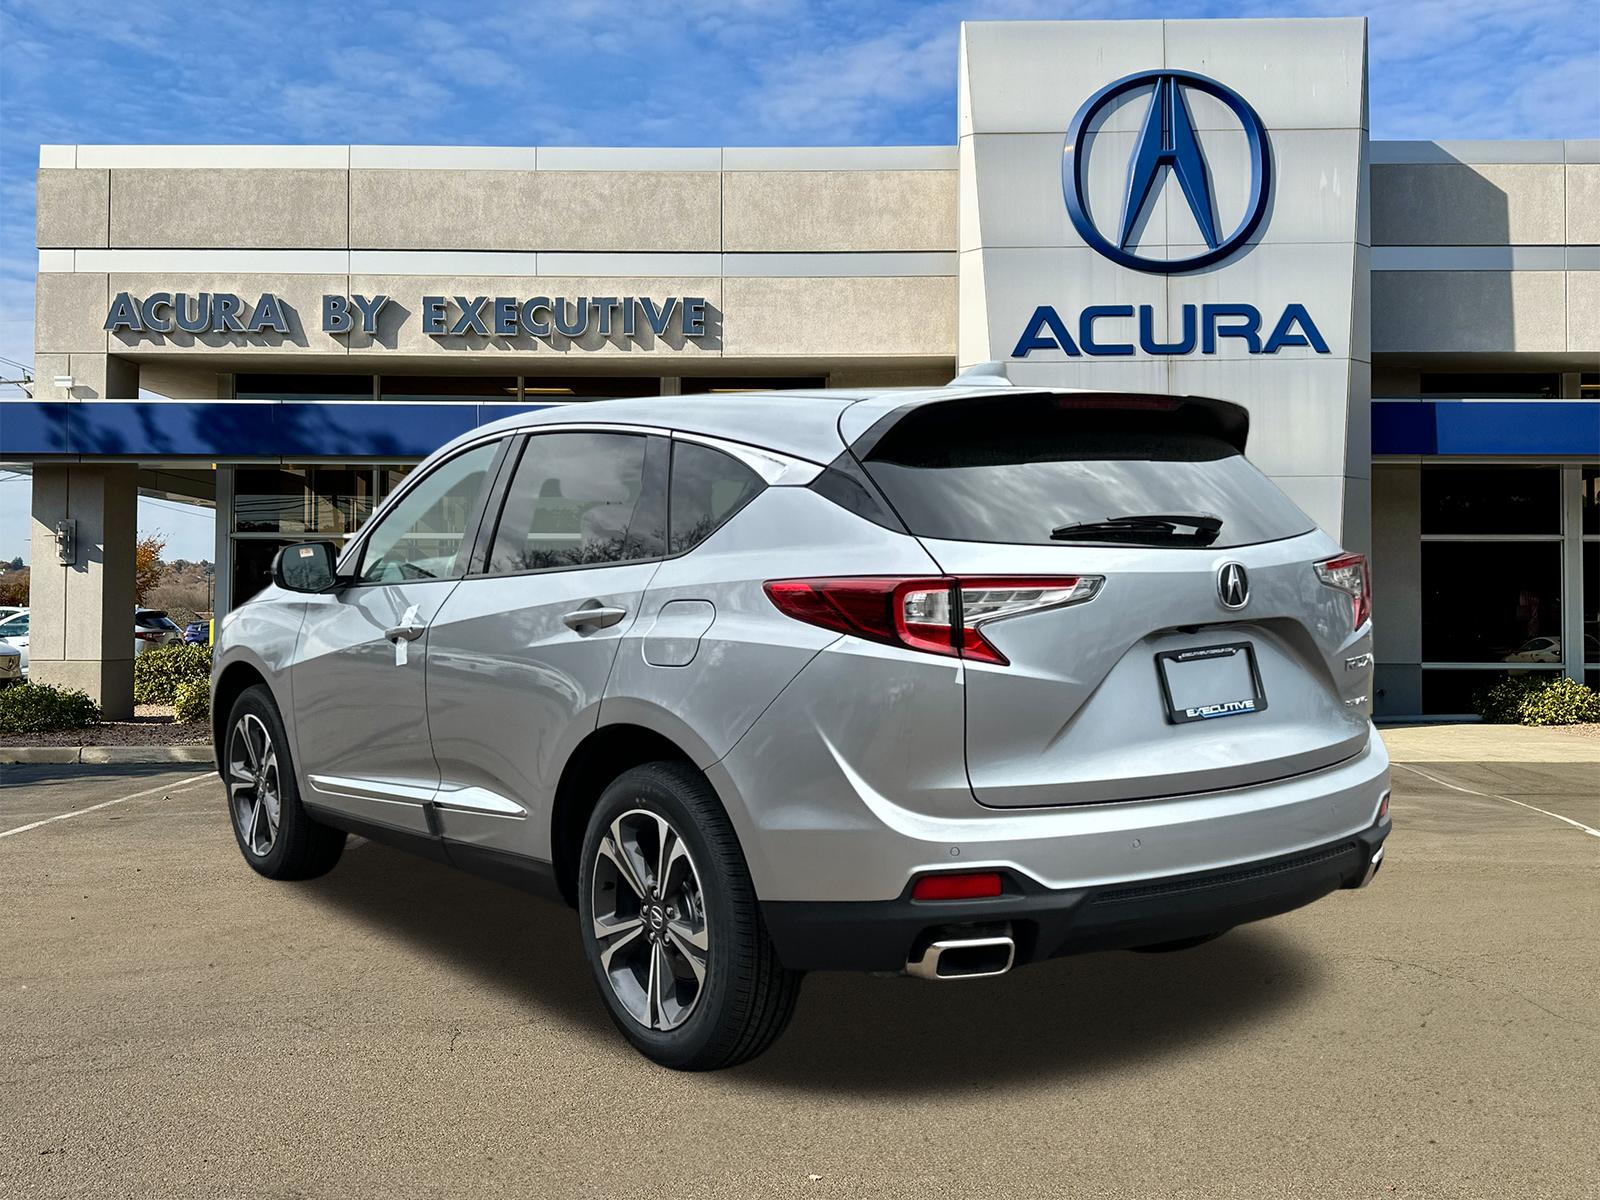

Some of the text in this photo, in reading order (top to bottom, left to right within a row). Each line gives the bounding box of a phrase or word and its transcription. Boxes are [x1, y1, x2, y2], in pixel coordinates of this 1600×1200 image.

[103, 292, 706, 337] ACURA BY EXECUTIVE
[1011, 303, 1332, 358] ACURA
[1186, 700, 1255, 717] EXECUTIVE
